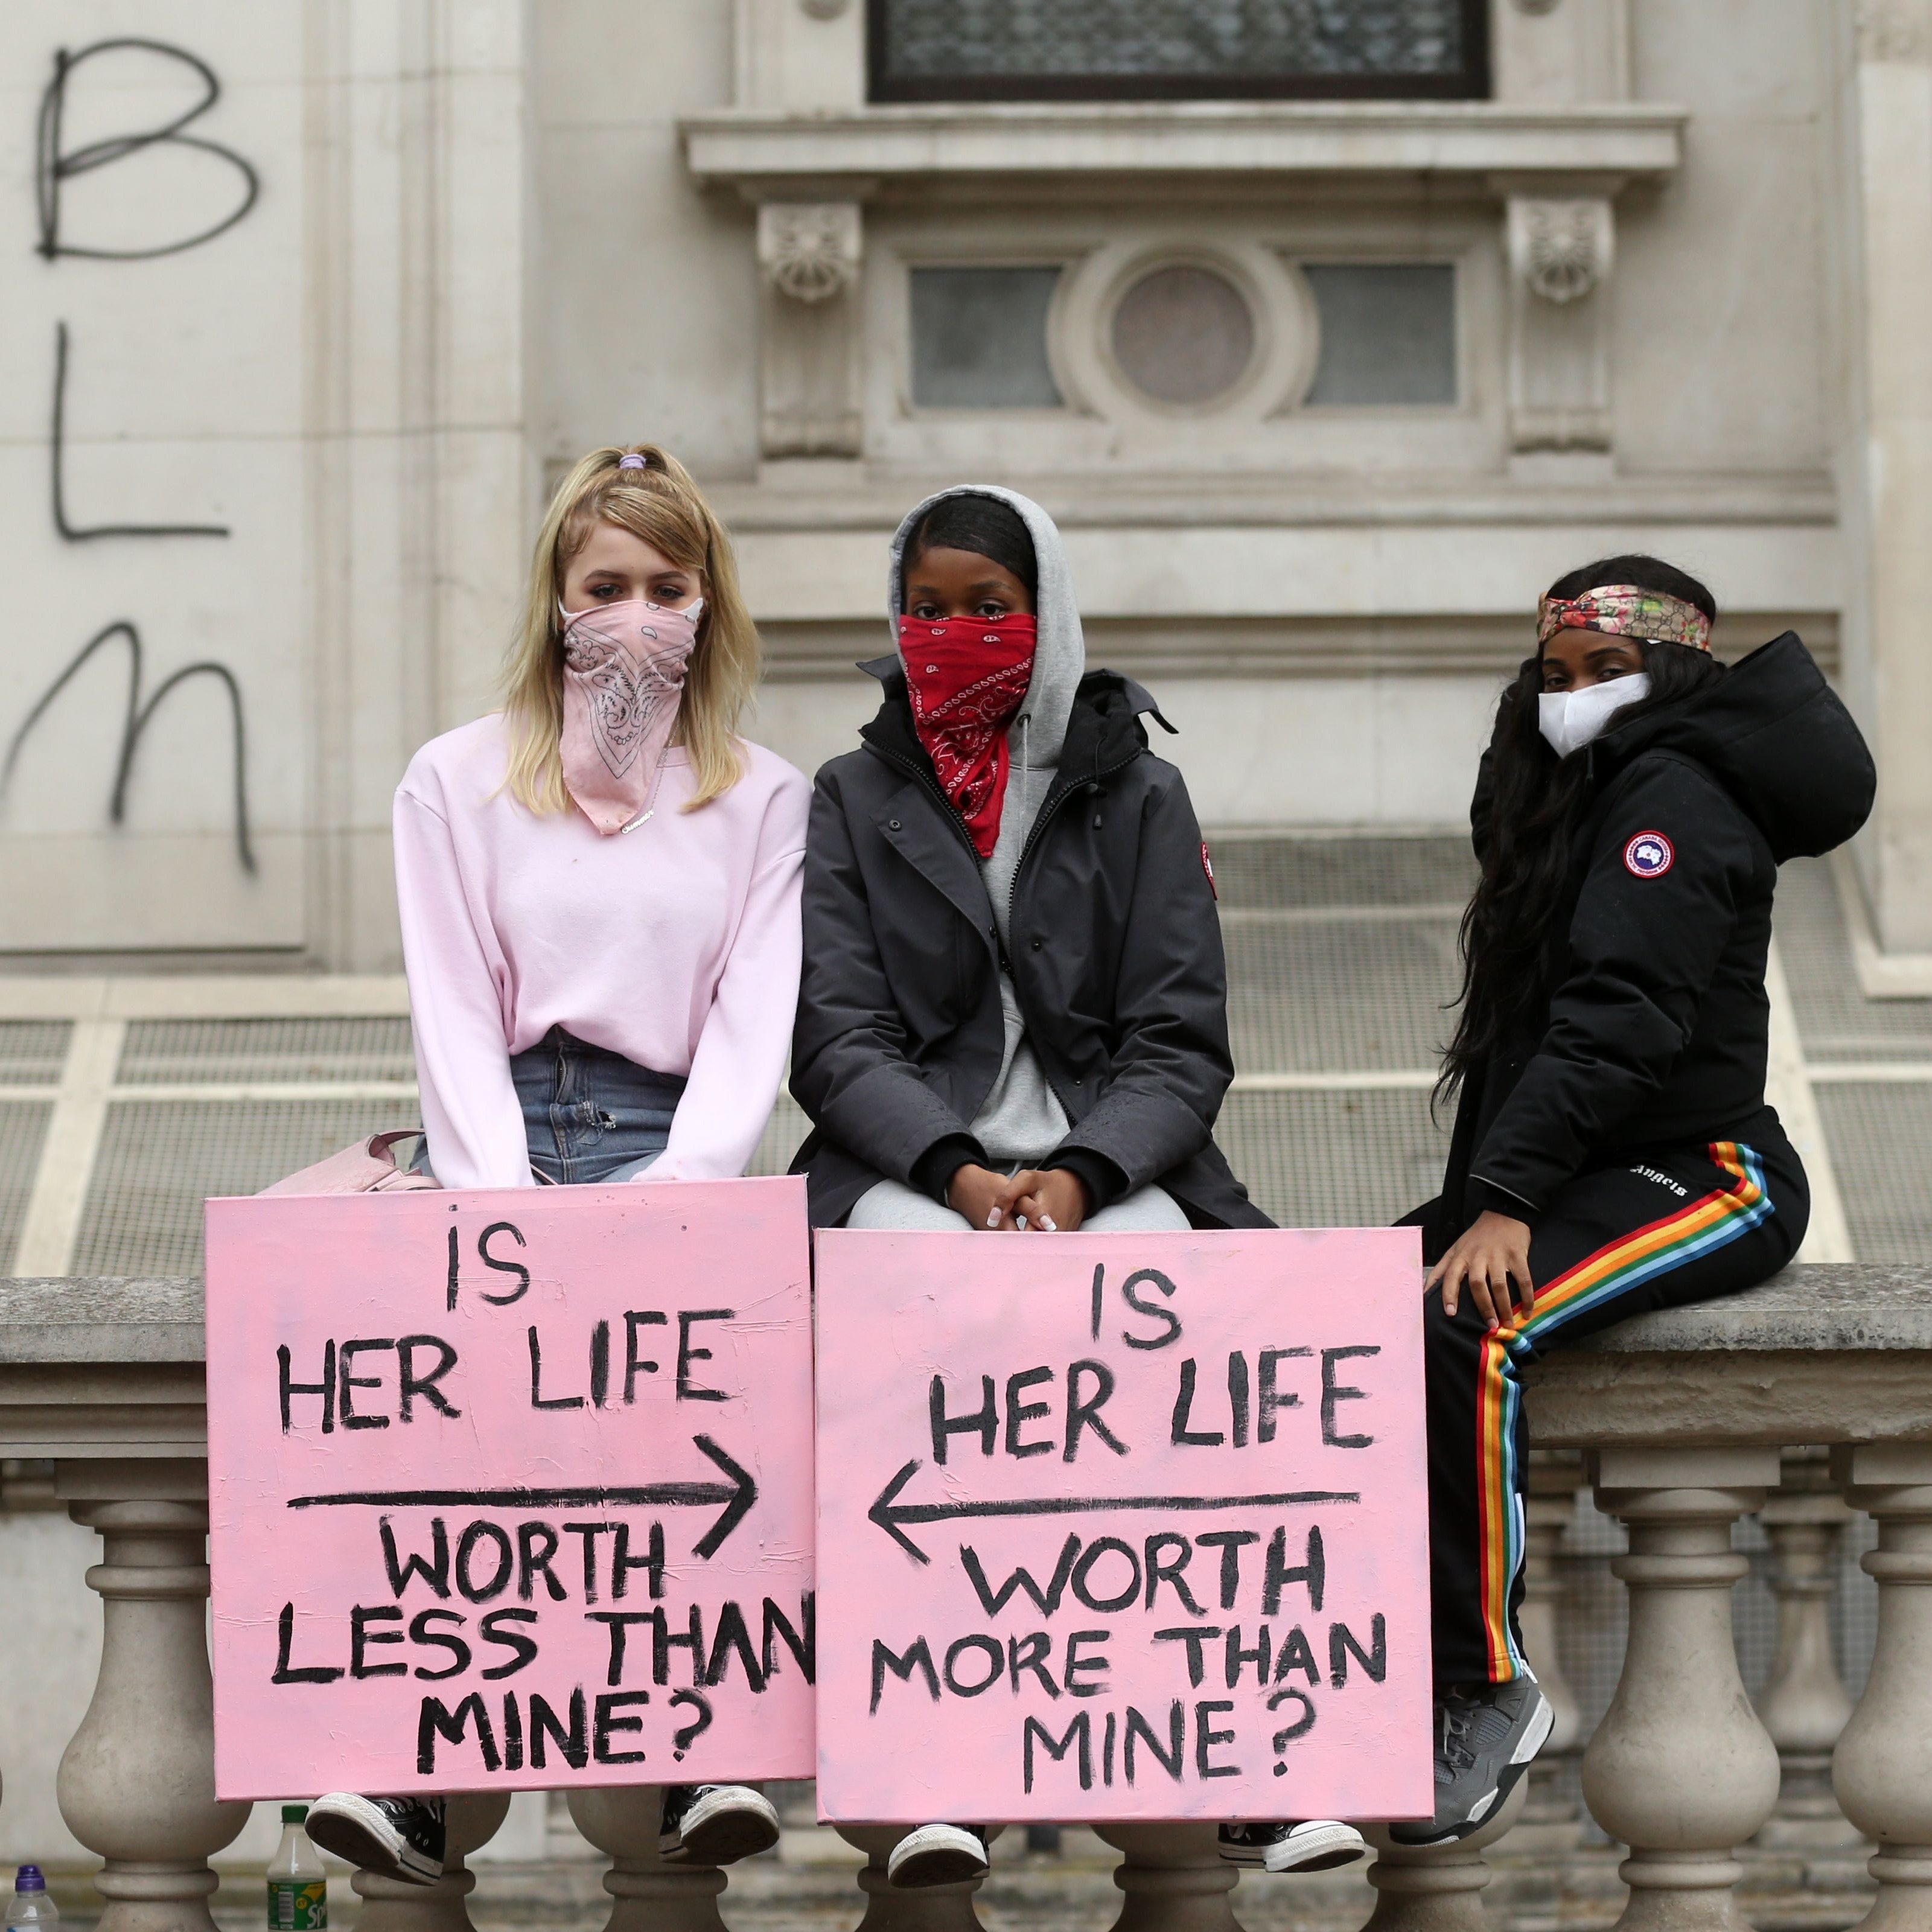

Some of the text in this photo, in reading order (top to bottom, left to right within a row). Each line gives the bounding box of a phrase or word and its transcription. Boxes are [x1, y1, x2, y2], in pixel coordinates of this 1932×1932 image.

[1091, 1263, 1183, 1351] IS
[276, 1308, 738, 1435] HER LIFE
[929, 1345, 1382, 1466] HER LIFE
[378, 1514, 668, 1605] WORTH
[960, 1524, 1325, 1619] WORTH
[271, 1590, 815, 1694] LESS THAN
[869, 1612, 1387, 1717] MORE THAN
[416, 1684, 713, 1775] MINE?
[1023, 1689, 1317, 1795] MINE?
